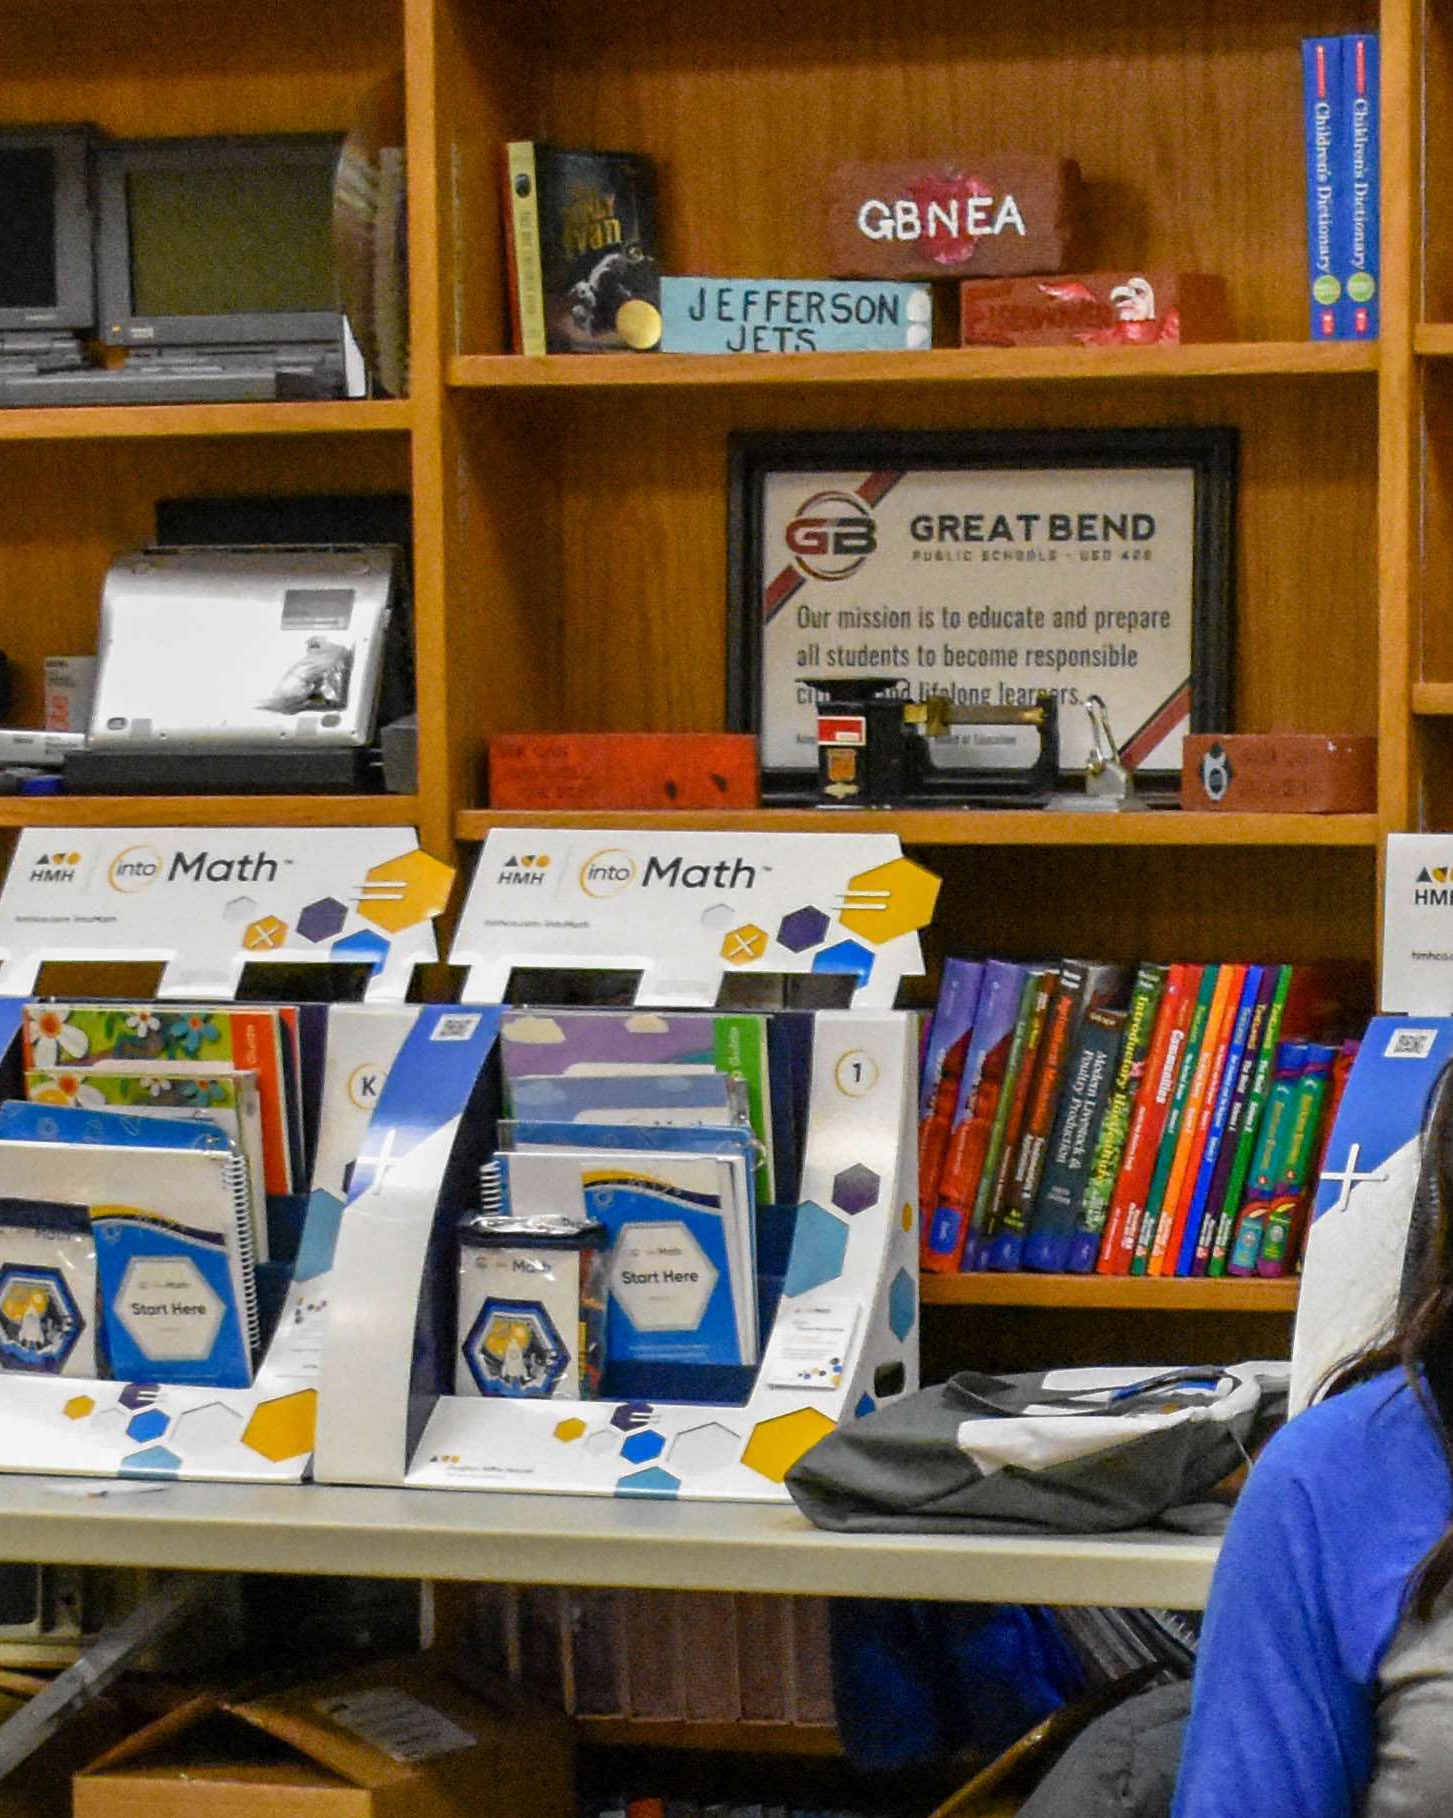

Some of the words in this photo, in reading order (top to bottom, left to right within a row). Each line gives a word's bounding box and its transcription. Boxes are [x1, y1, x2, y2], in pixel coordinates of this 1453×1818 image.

[857, 194, 1026, 242] GBNEA
[1316, 186, 1332, 273] Dictionary
[1351, 182, 1368, 270] Dictionary
[688, 287, 899, 325] JEFFERSON
[726, 326, 816, 351] JETS
[785, 517, 878, 556] GB
[910, 513, 1040, 542] GREAT
[1049, 513, 1156, 542] BEND
[797, 606, 829, 629] Our
[838, 607, 911, 628] mission
[918, 606, 935, 628] is
[942, 608, 961, 628] to
[967, 606, 1045, 628] educate
[1053, 606, 1087, 628] and
[1094, 609, 1171, 634] prepare
[797, 645, 820, 667] all
[828, 646, 909, 668] students
[917, 647, 936, 667] to
[944, 645, 1018, 668] become
[1026, 645, 1138, 672] responsible
[30, 870, 74, 882] HMH
[117, 860, 156, 876] into
[498, 872, 545, 885] HMH
[587, 864, 630, 881] into
[1116, 996, 1149, 1090] Introductory
[361, 1074, 379, 1097] K
[851, 1060, 863, 1085] 1
[1072, 1048, 1093, 1094] Poultry
[1086, 1050, 1108, 1098] Modern
[1057, 1096, 1084, 1164] Production
[1072, 1099, 1096, 1155] Livestock
[1069, 1158, 1082, 1169] &
[621, 1270, 658, 1285] Start
[663, 1270, 699, 1285] Here
[131, 1301, 169, 1316] Start
[171, 1301, 208, 1317] Here
